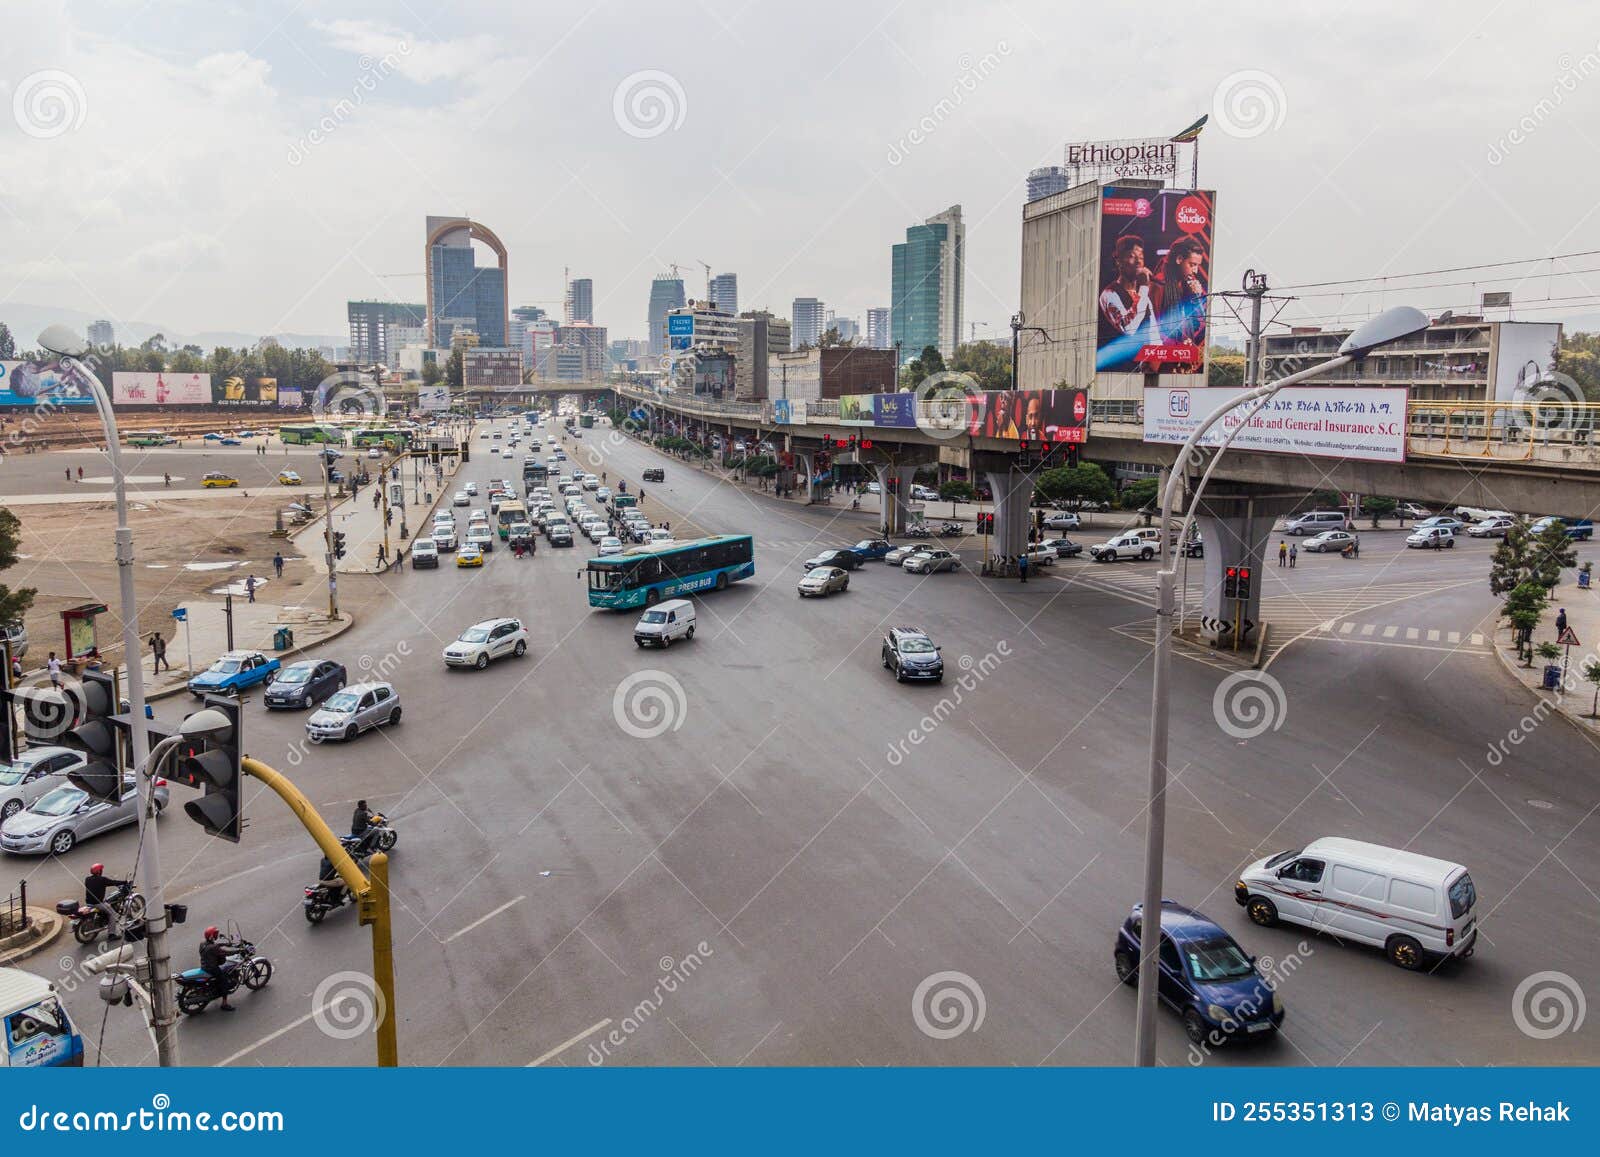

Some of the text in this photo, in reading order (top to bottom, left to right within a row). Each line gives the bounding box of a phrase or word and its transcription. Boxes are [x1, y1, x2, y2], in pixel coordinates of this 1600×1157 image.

[1068, 142, 1174, 165] Ethiopian
[1177, 211, 1206, 225] Studio
[1247, 416, 1264, 428] Life
[1266, 417, 1283, 430] and
[1285, 418, 1322, 431] General
[1325, 420, 1375, 434] Insurance
[1378, 422, 1401, 436] S.C.
[699, 577, 712, 587] BUS
